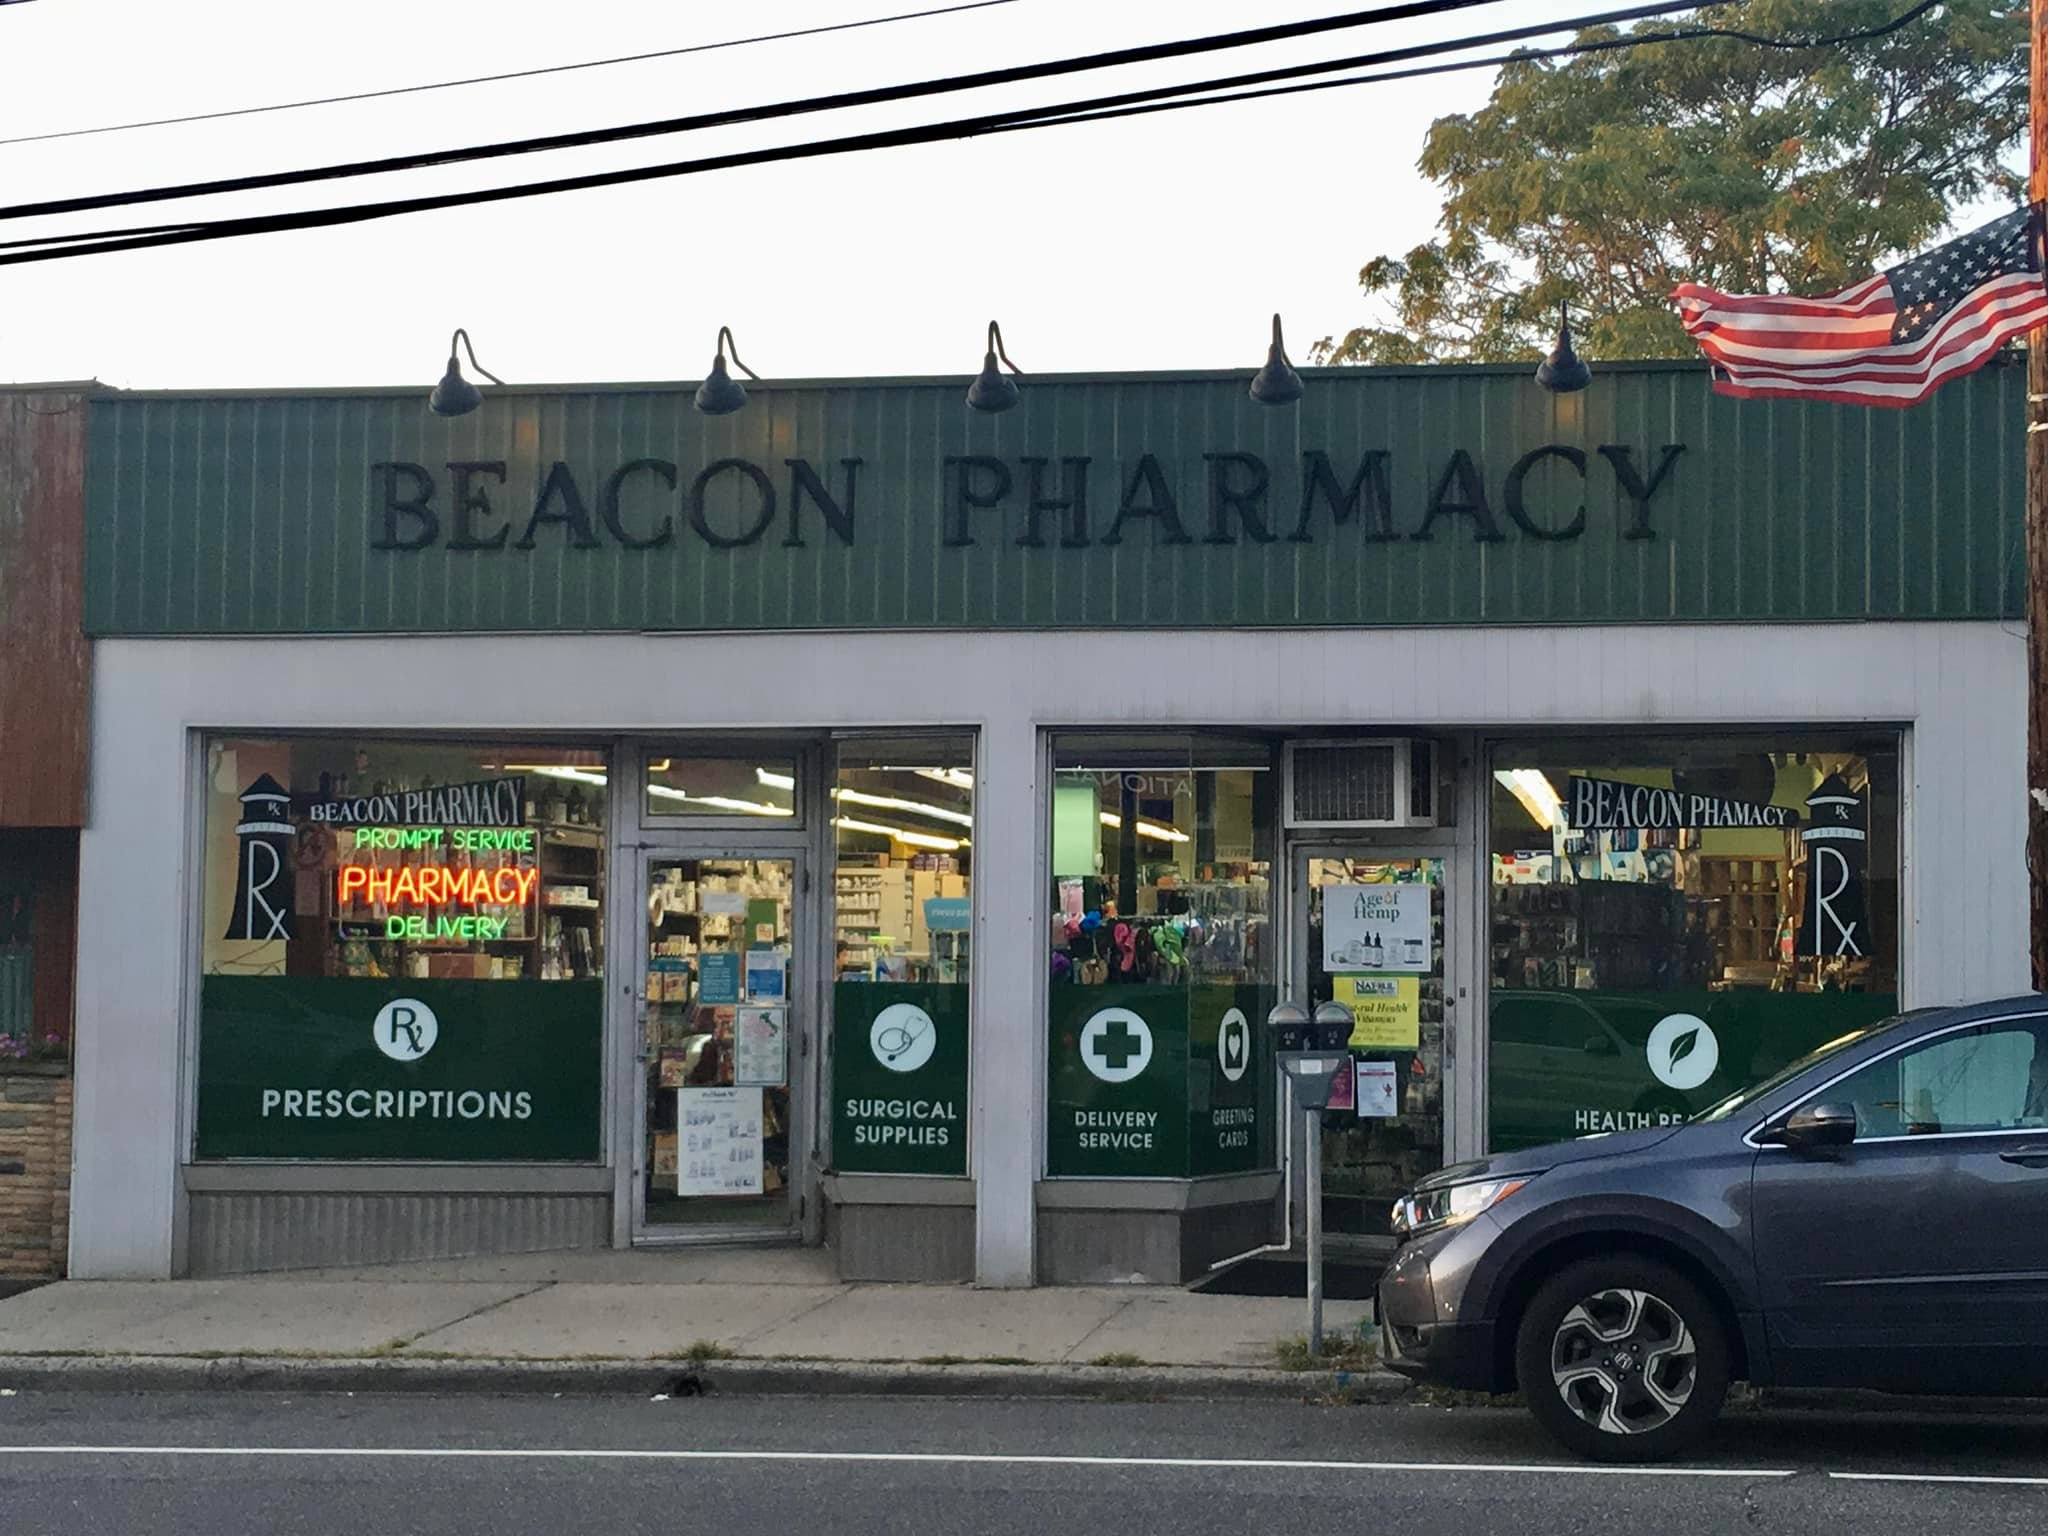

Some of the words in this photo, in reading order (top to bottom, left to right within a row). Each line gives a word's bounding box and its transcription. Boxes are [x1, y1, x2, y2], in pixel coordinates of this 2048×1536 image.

[371, 457, 864, 551] BEACON
[942, 445, 1689, 548] PHARMACY
[310, 793, 399, 823] BEACON
[405, 779, 521, 826] PHARMACY
[1575, 777, 1684, 829] BEACON
[1690, 795, 1788, 827] PHAMACY
[355, 828, 443, 850] PROMPT
[453, 829, 534, 851] SERVICE
[341, 865, 538, 905] PHARMACY
[1354, 891, 1383, 908] Age
[1354, 905, 1400, 923] Hemp
[387, 915, 508, 939] DELIVERY
[262, 1089, 533, 1120] PRESCRIPTIONS
[846, 1099, 957, 1121] SURGICAL
[1075, 1111, 1159, 1128] DELIVERY
[1212, 1107, 1255, 1127] GREETING
[1575, 1109, 1650, 1132] HEALTH
[854, 1125, 950, 1147] SUPPLIES
[1079, 1132, 1153, 1149] SERVICE
[1219, 1130, 1249, 1148] CARDS
